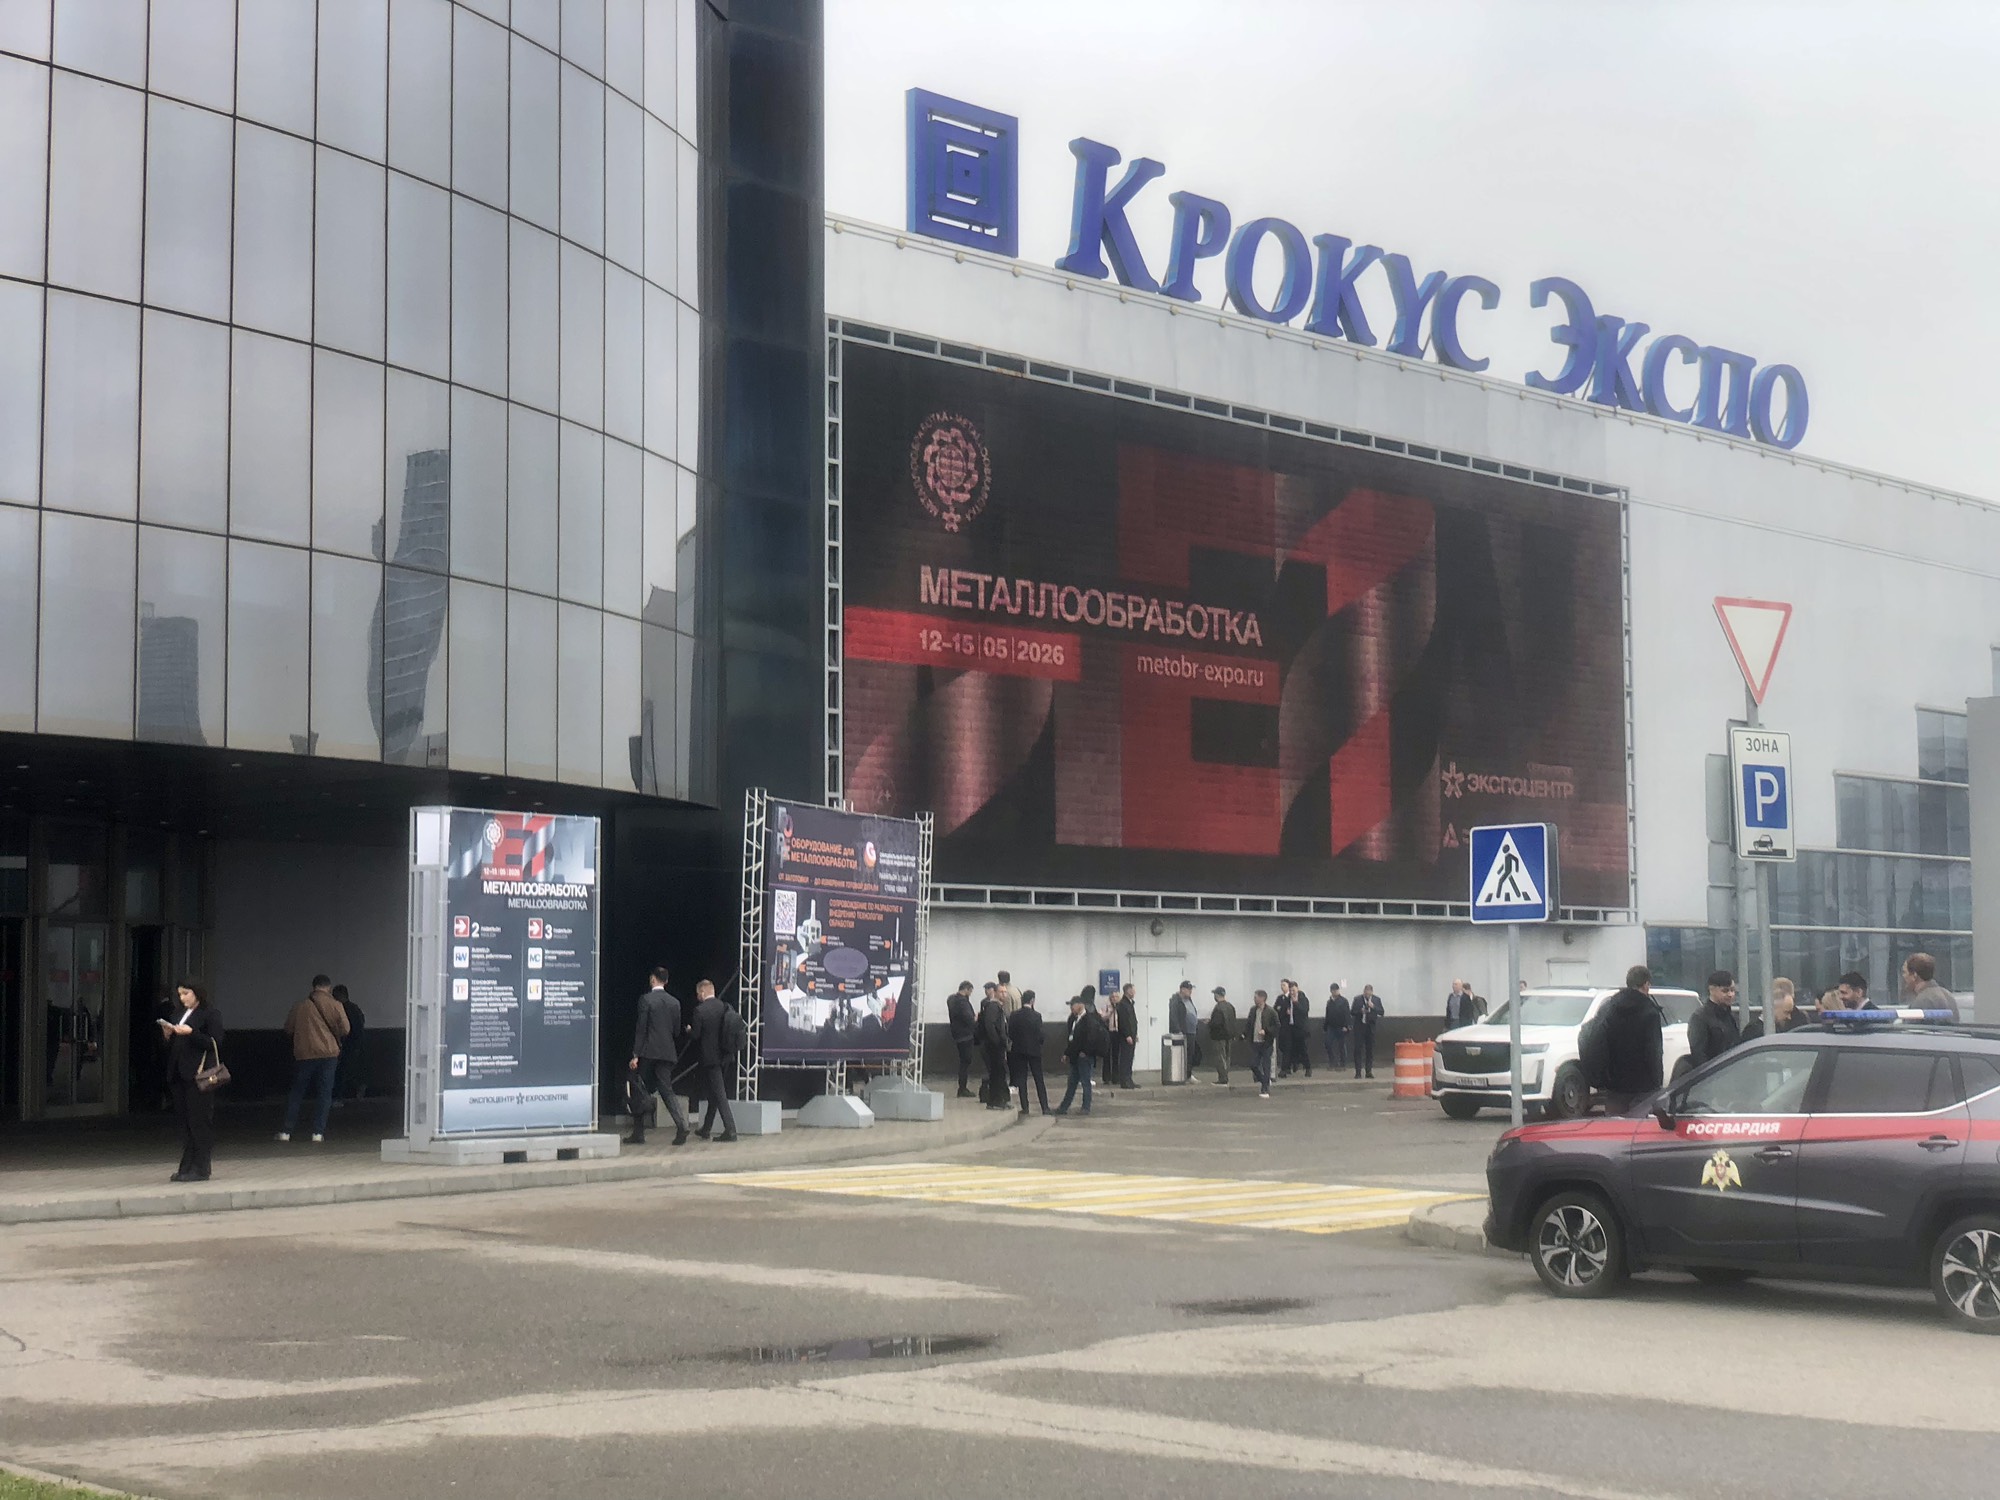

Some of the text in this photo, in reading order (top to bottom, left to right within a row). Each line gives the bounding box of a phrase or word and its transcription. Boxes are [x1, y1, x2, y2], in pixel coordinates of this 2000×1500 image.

[1055, 136, 1809, 451] КРОКУС ЭКСПО
[920, 564, 1263, 647] МЕТАЛЛООБРАБОТКА
[1137, 654, 1264, 688] metobr-expo.ru
[1745, 737, 1779, 753] ЗОНА
[1467, 773, 1575, 799] ЭКСПОЦЕНТР
[1754, 771, 1779, 822] P
[791, 837, 842, 855] ОБОРУДОВАНИЕ
[483, 880, 588, 898] МЕТАЛЛООБРАБОТКА
[508, 898, 588, 910] METALLOOBRABOTKA
[471, 922, 480, 938] 2
[545, 924, 553, 939] 3
[1686, 1122, 1781, 1136] РОСГВАРДИЯ
